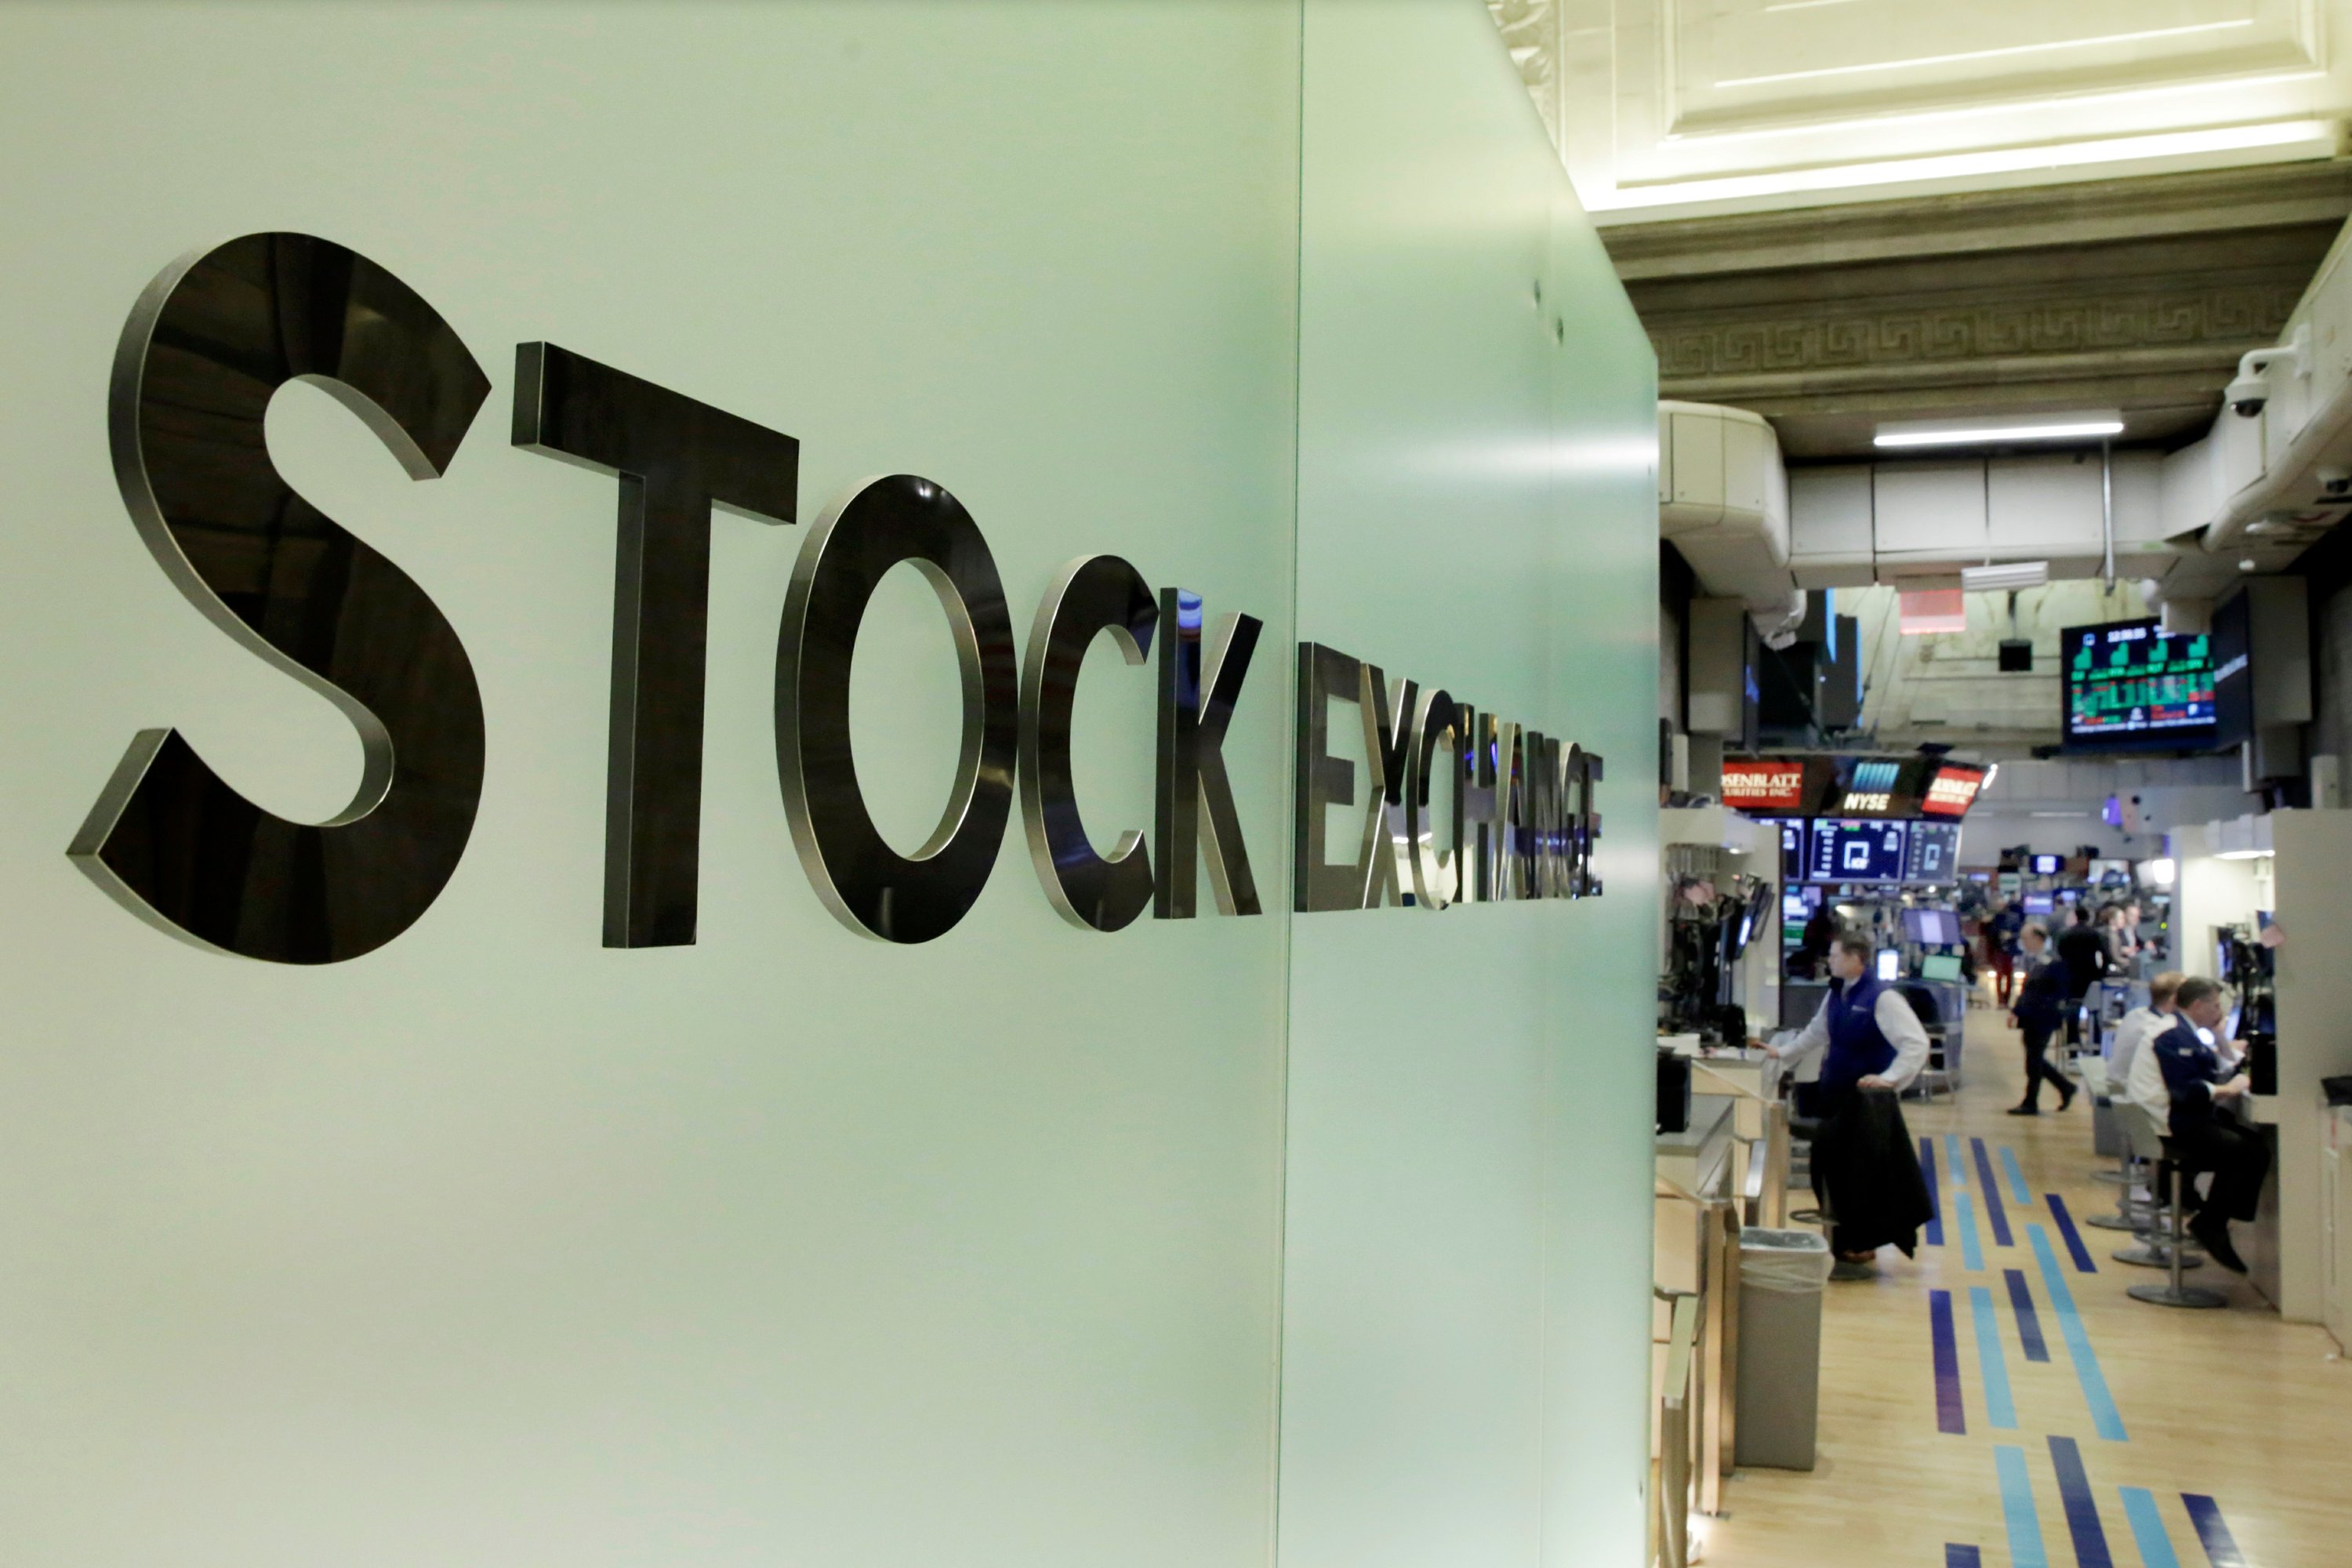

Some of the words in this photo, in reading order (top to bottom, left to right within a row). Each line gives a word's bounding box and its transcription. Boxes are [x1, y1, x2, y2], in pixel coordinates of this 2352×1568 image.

[67, 232, 1264, 966] STOCK
[1294, 641, 1603, 911] EXCHANGE
[1844, 793, 1891, 811] NYSE
